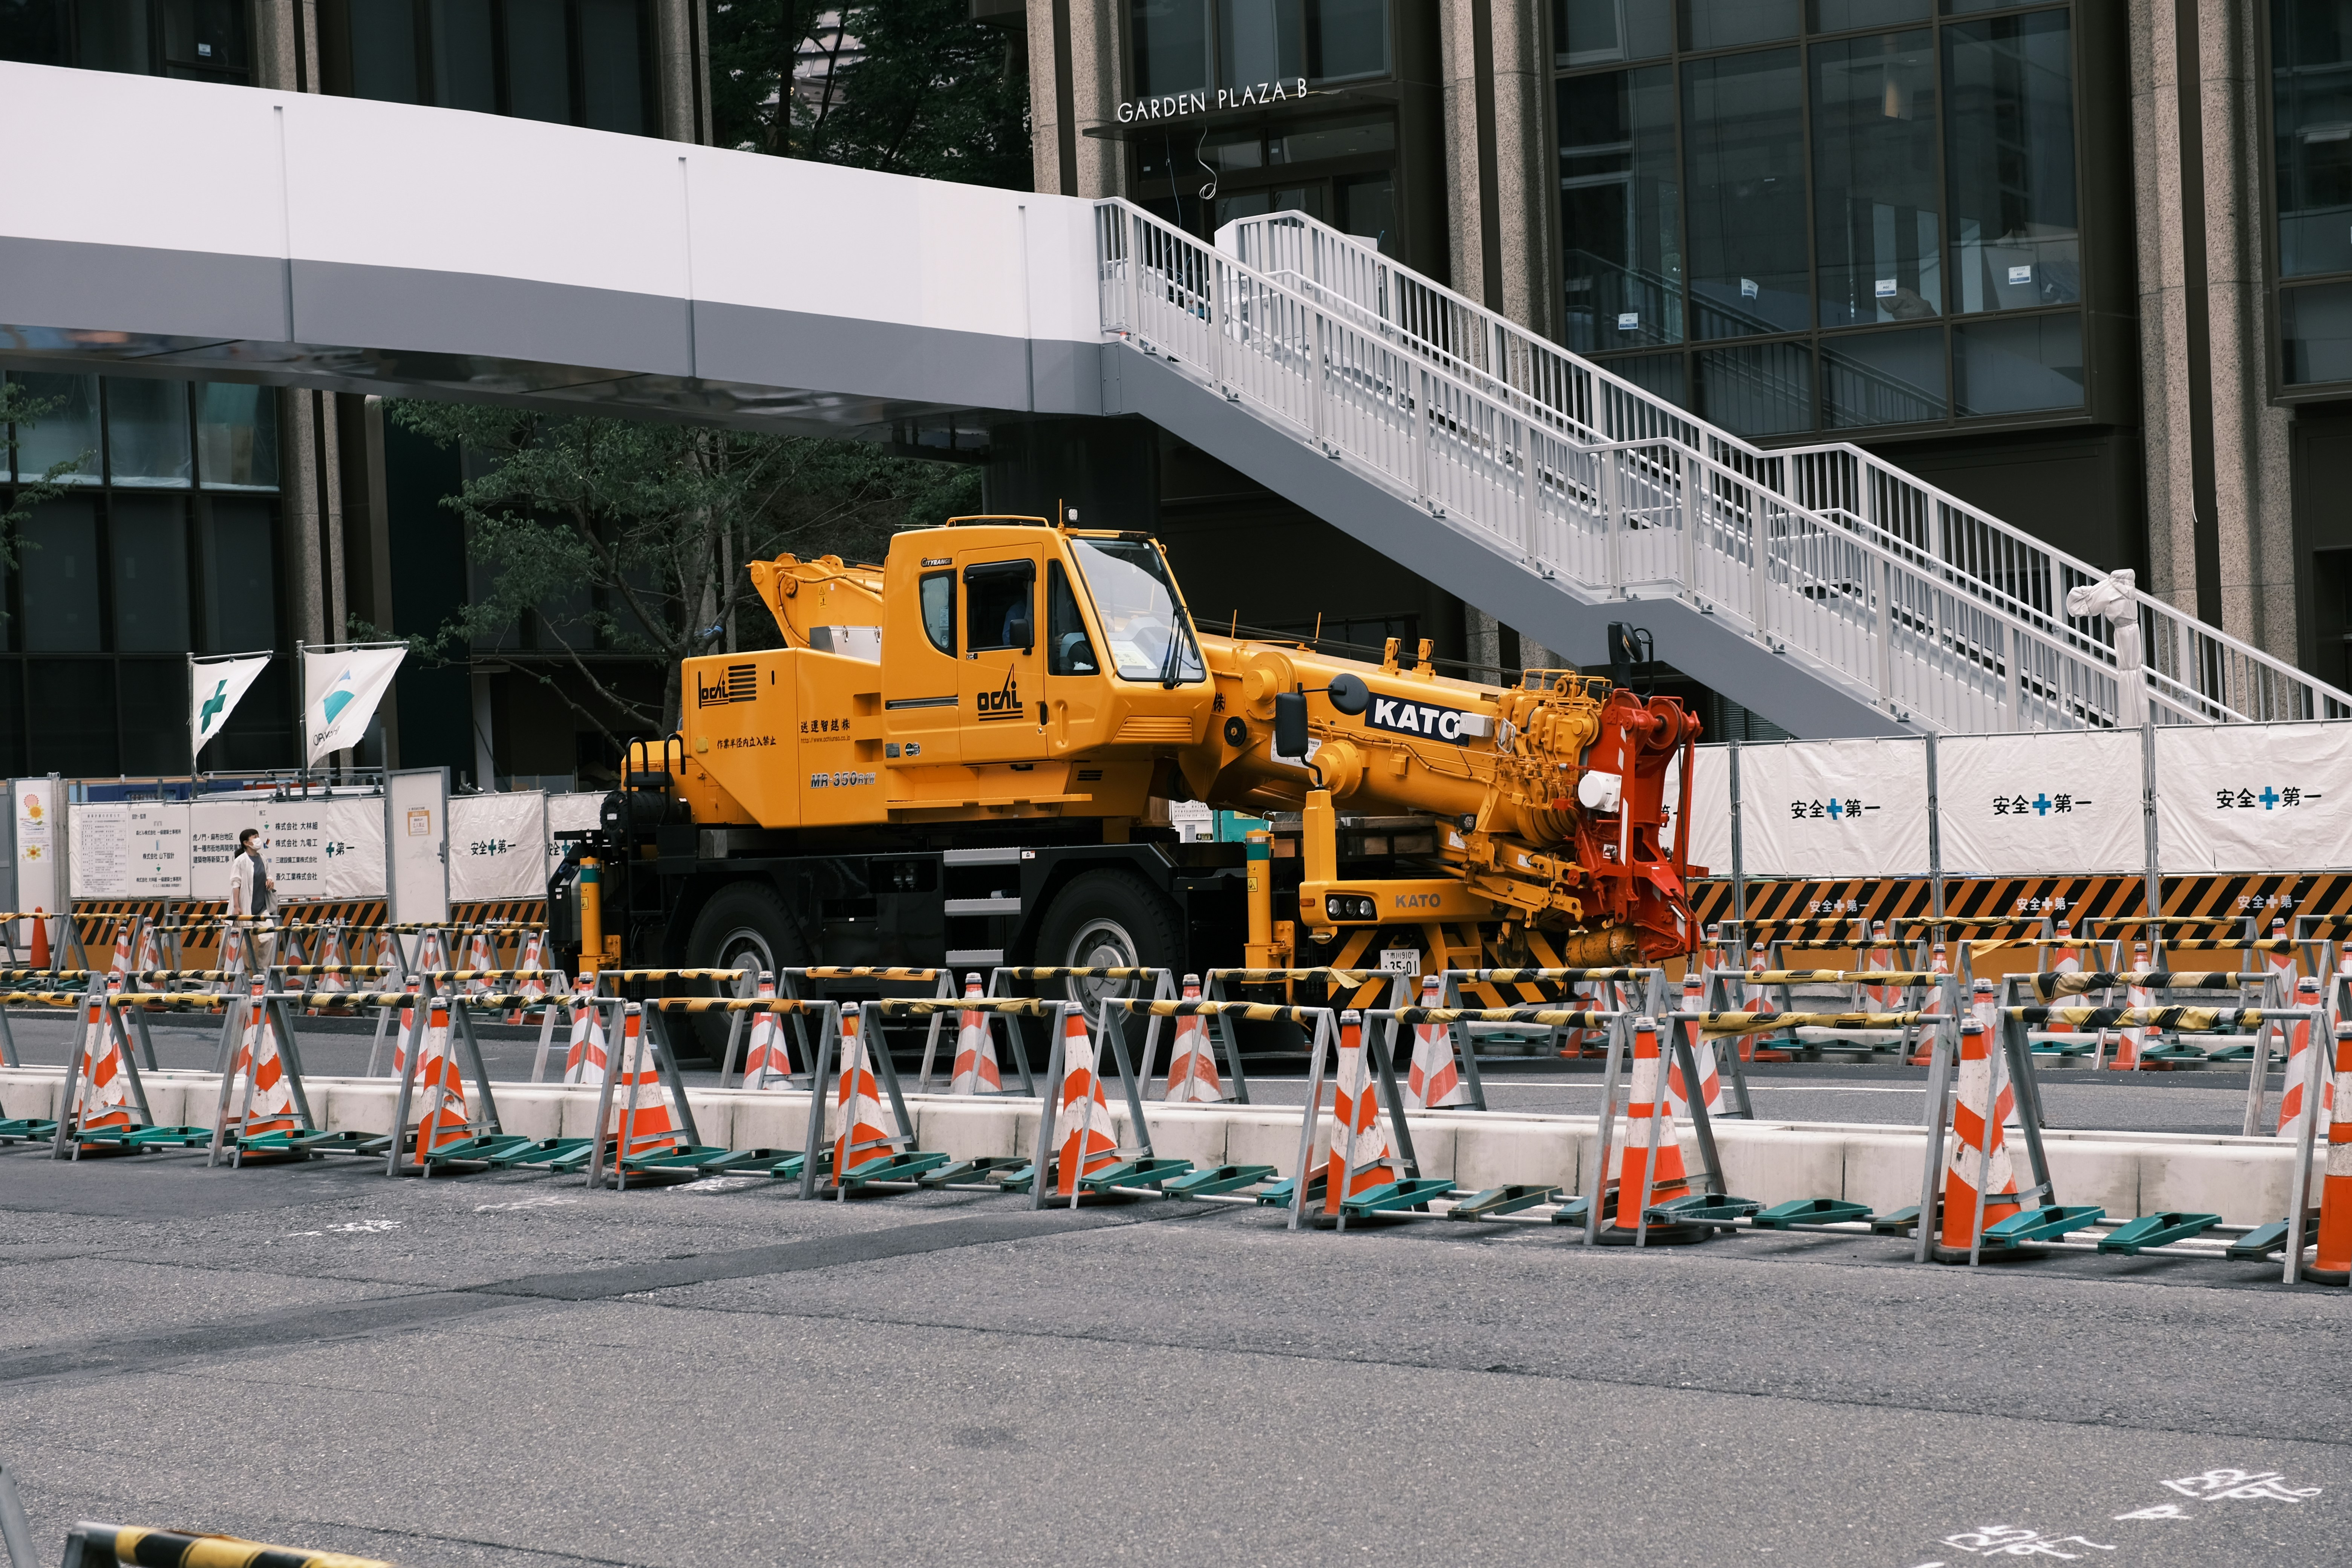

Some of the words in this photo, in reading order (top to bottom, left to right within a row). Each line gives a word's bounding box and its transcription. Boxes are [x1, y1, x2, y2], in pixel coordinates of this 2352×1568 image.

[1118, 92, 1205, 123] GARDEN
[1218, 81, 1286, 109] PLAZA
[1297, 78, 1308, 98] B
[1374, 698, 1461, 740] KATO
[717, 735, 776, 749] 作業半径内立入禁止
[300, 822, 318, 830] 大林組
[276, 839, 297, 848] 株式会社
[300, 839, 317, 847] 九電工
[1395, 893, 1441, 908] KATO
